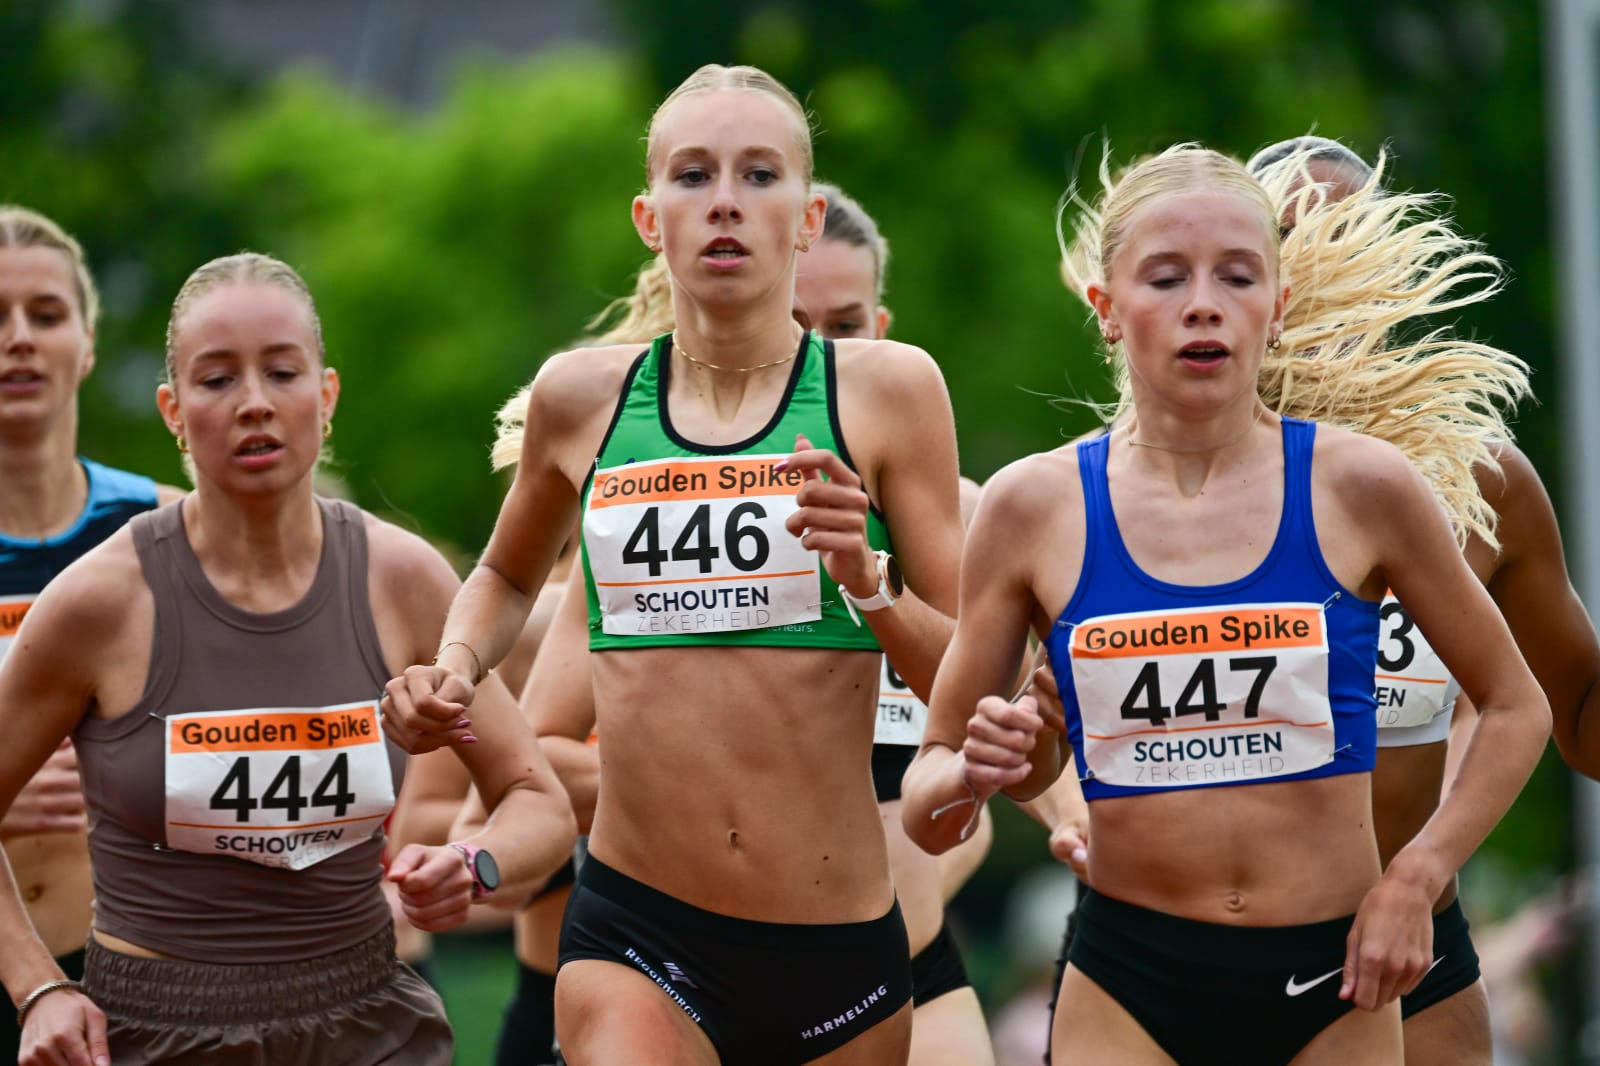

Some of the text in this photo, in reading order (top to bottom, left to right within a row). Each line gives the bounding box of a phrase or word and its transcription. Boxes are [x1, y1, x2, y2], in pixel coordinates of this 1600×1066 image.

[602, 464, 801, 498] Gouden Spike
[622, 501, 770, 577] 446
[635, 586, 769, 613] SCHOUTEN
[637, 609, 771, 632] ZEKERHEID
[1085, 615, 1310, 650] Gouden Spike
[1120, 655, 1278, 726] 447
[181, 714, 371, 745] Gouden Spike
[1134, 731, 1283, 763] SCHOUTEN
[1135, 756, 1286, 783] ZEKERHEID
[209, 752, 356, 823] 444
[215, 827, 344, 854] SCHOUTEN
[801, 984, 888, 1039] HARMELING
